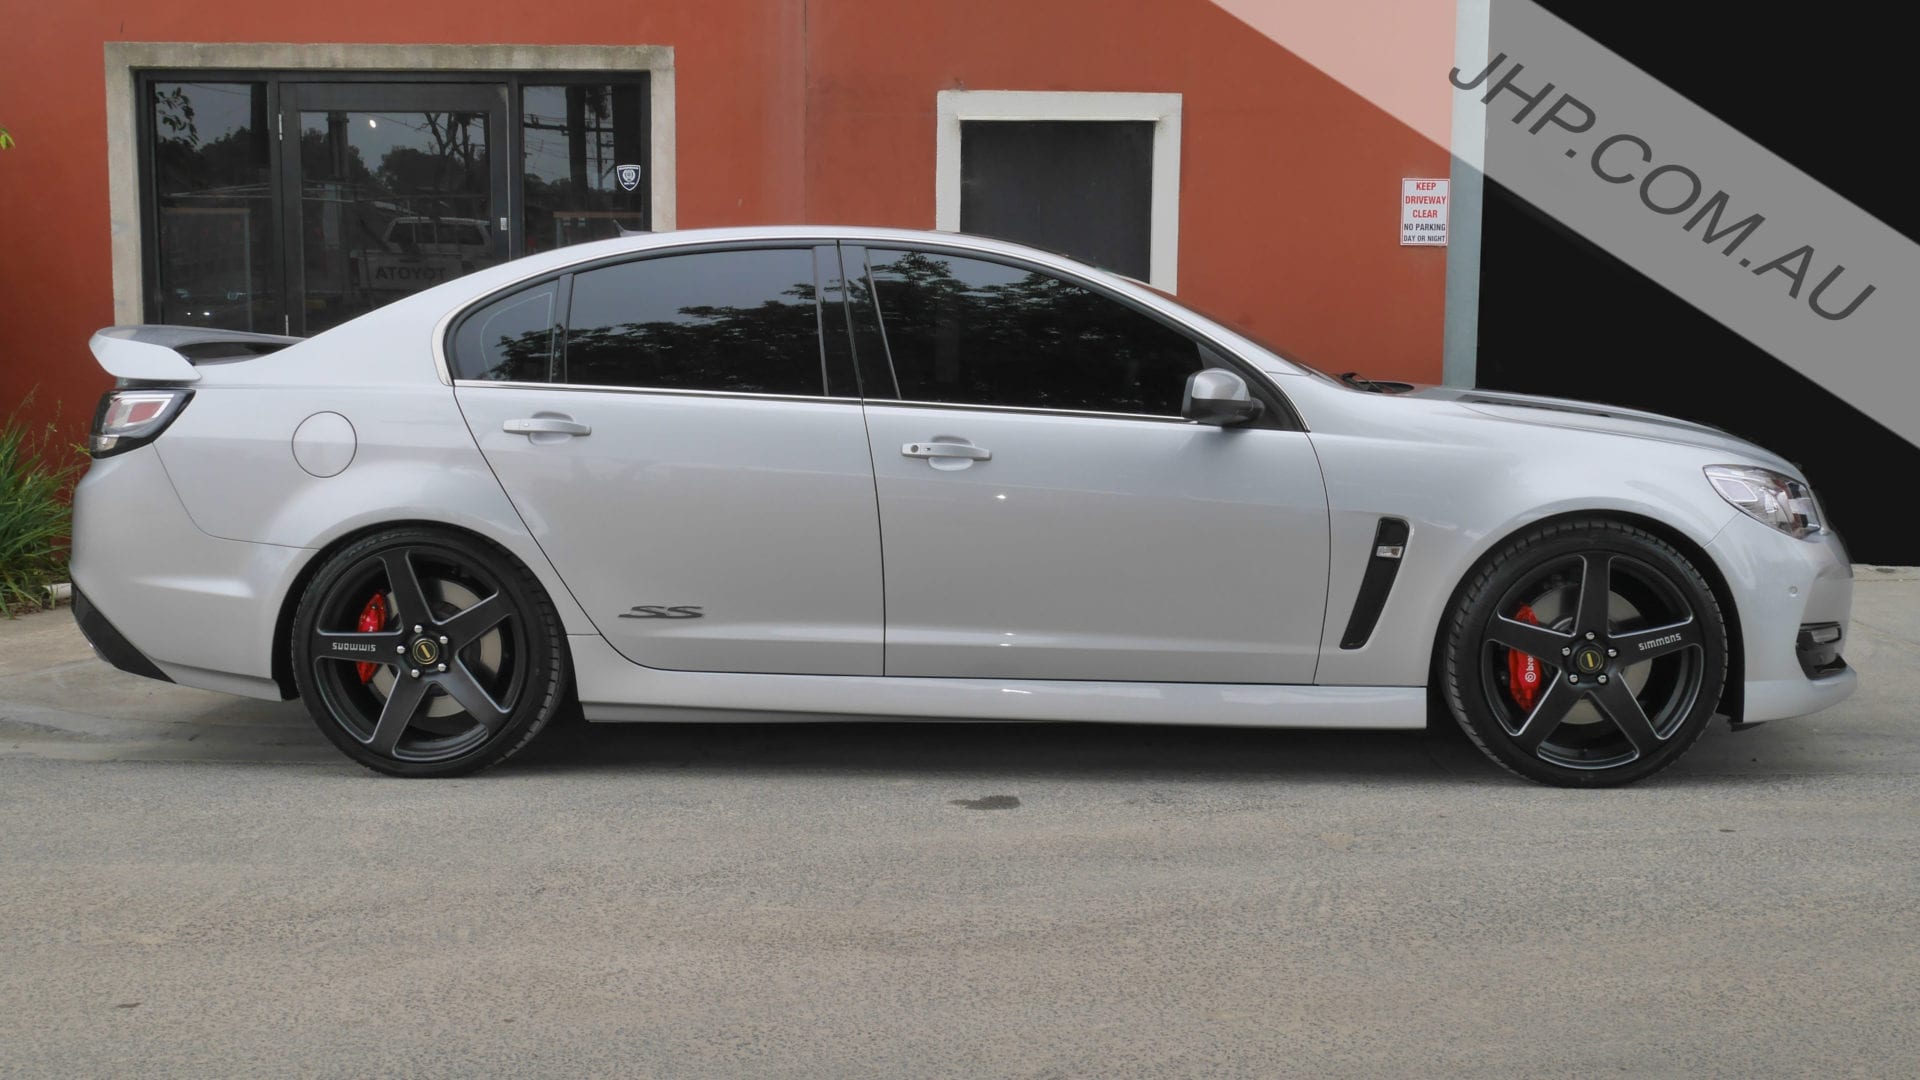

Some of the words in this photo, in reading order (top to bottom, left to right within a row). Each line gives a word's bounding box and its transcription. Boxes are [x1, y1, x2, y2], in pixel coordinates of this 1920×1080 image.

[1416, 182, 1436, 190] KEEP
[1405, 196, 1446, 204] DRIVEWAY
[1412, 210, 1438, 218] CLEAR
[1404, 223, 1413, 231] NO
[1415, 223, 1446, 231] PARKING
[618, 605, 704, 619] SS
